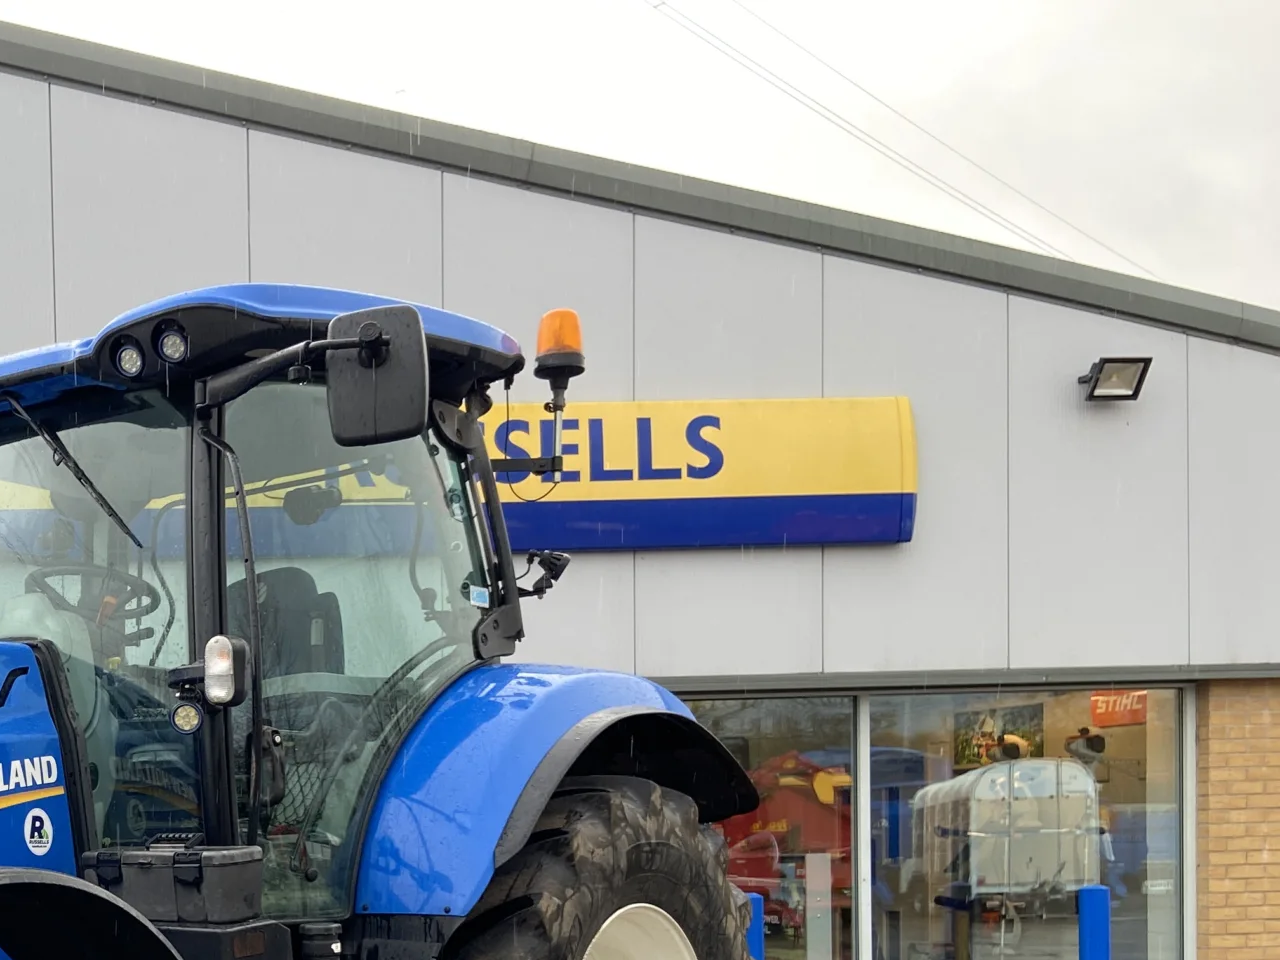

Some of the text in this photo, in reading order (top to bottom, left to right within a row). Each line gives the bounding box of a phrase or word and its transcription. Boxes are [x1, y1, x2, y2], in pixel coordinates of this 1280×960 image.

[470, 415, 724, 483] SELLS
[1096, 694, 1143, 713] STIHL
[30, 815, 45, 839] R
